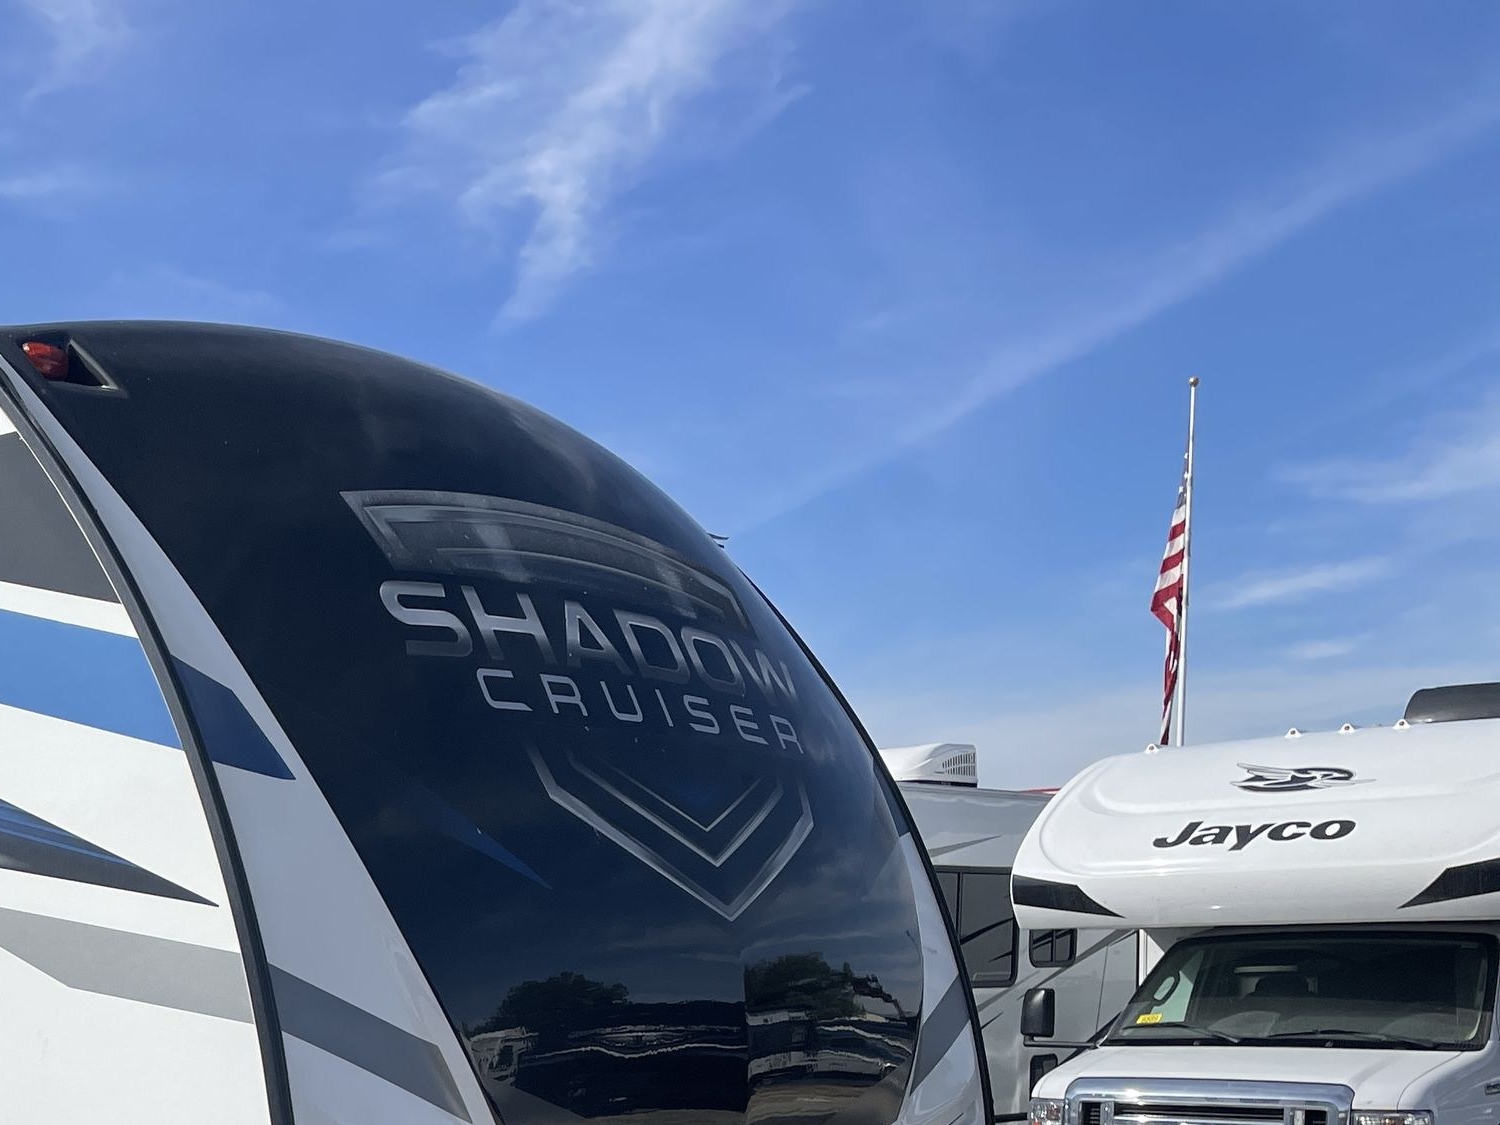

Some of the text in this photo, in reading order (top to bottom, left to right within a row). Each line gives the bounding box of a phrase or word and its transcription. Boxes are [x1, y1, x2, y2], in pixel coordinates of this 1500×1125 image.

[379, 580, 798, 706] SHADOW
[476, 667, 804, 754] CRUISER
[1152, 820, 1356, 851] Jayco
